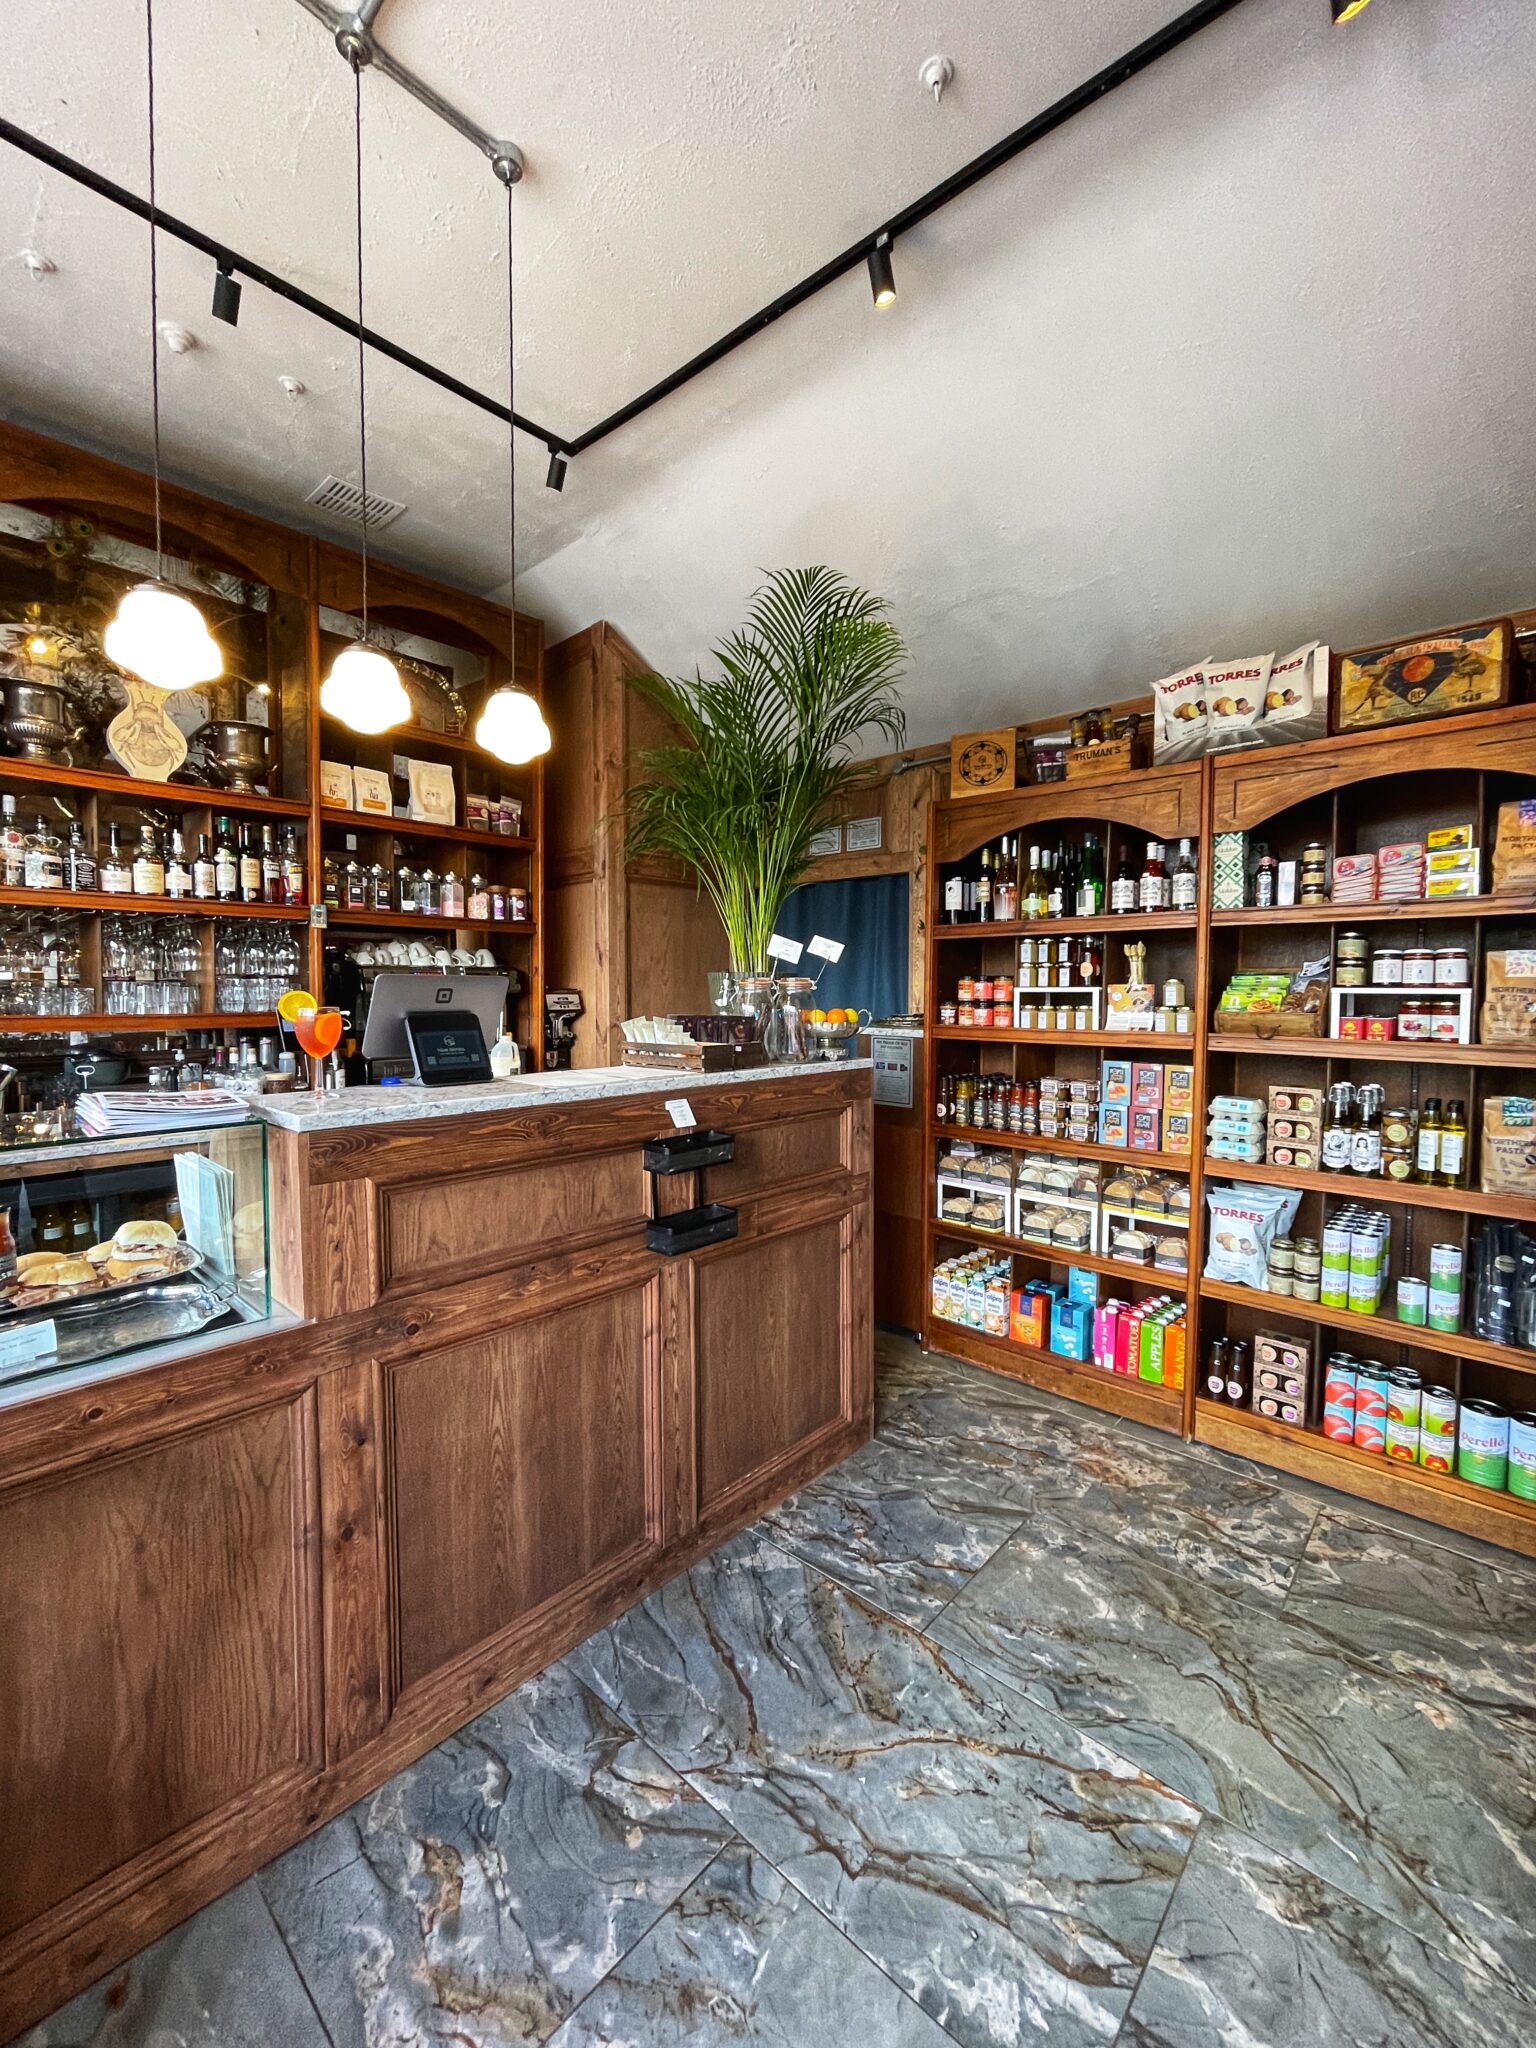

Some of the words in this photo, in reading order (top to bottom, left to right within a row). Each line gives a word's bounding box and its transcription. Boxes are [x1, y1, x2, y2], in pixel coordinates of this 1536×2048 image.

[1208, 667, 1261, 685] TORRES
[1270, 657, 1304, 678] RRES
[1161, 671, 1204, 694] TORRE
[1075, 745, 1121, 761] TRUMAN'S
[1212, 1206, 1265, 1223] TORRES
[950, 1283, 965, 1293] alpro
[967, 1288, 983, 1298] alpro
[986, 1294, 1002, 1303] alpro
[1127, 1320, 1140, 1375] TOMATOES
[1150, 1325, 1162, 1371] APPLES
[1174, 1331, 1185, 1391] ORANGES
